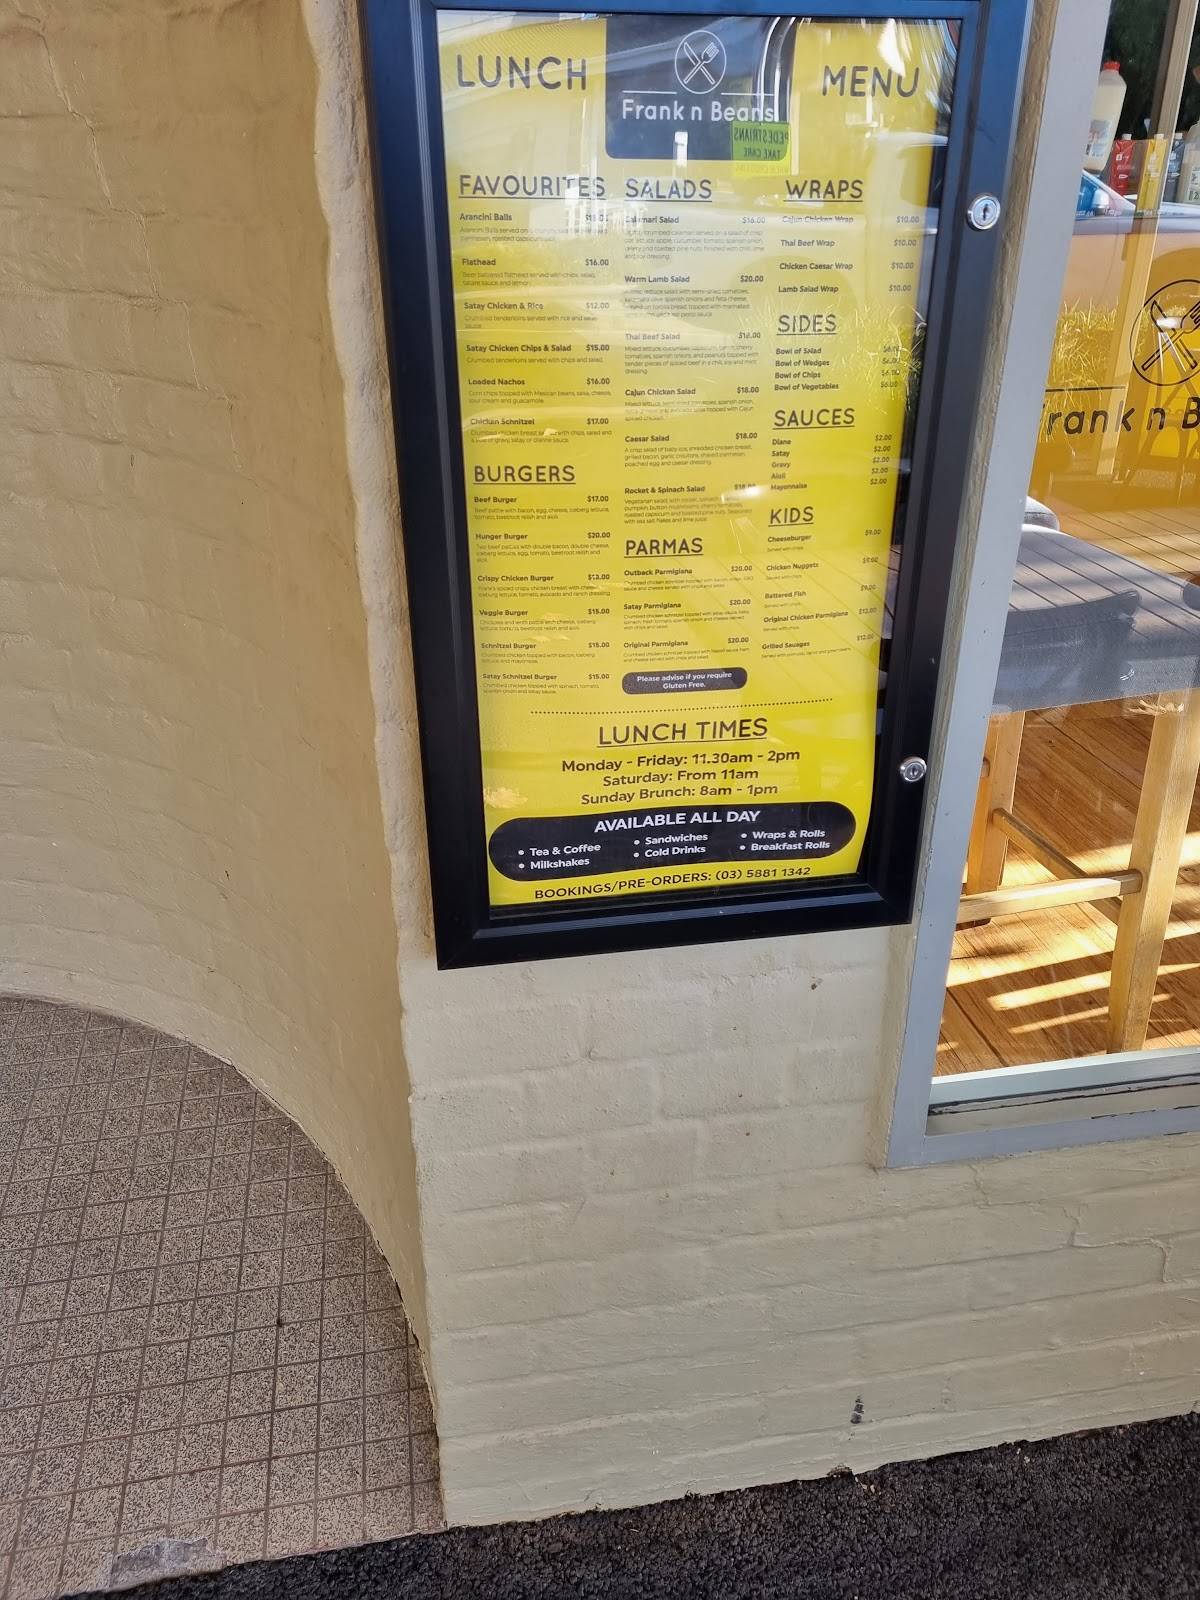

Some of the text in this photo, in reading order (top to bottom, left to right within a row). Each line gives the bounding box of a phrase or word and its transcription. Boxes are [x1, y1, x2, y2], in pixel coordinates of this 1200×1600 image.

[457, 54, 586, 90] LUNCH
[822, 65, 919, 97] MENU
[622, 99, 773, 121] Frank n Beans
[460, 175, 606, 197] FAVOURITES
[625, 178, 713, 199] SALADS
[785, 180, 864, 199] WRAPS
[460, 213, 512, 221] Arancini Balls
[778, 314, 837, 333] SIDES
[625, 389, 645, 397] Cajun
[774, 408, 855, 427] SAUCES
[1042, 400, 1136, 435] rank
[1147, 407, 1166, 430] n
[624, 435, 649, 443] Caesar
[772, 450, 790, 458] Satay
[474, 465, 575, 482] BURGERS
[771, 483, 808, 491] Mayonnaise
[492, 496, 517, 504] Burger
[587, 495, 609, 503] $17.00
[770, 506, 814, 524] KIDS
[475, 533, 502, 541] Hunger
[767, 535, 812, 543] Cheeseburger
[625, 537, 703, 555] PARMAS
[624, 568, 693, 577] Outback Parmigiana
[478, 575, 499, 583] Crispy
[479, 609, 528, 617] Veggie Burger
[624, 602, 681, 612] Satay Parmigiana
[764, 615, 788, 623] Original
[815, 611, 848, 619] Parmigiana
[624, 640, 688, 650] Original Parmigiana
[727, 636, 749, 644] $20.00
[663, 682, 687, 690] Gluten
[599, 717, 768, 745] LUNCH TIMES
[561, 750, 800, 773] Monday Friday: 11.30am 2pm
[603, 769, 759, 787] Saturday: From 11am
[581, 784, 778, 806] Sunday Brunch: 8am 1pm
[594, 810, 760, 833] AVAILABLE ALL DAY
[645, 833, 708, 845] Sandwiches
[752, 829, 826, 840] Wraps Rolls
[530, 844, 601, 857] Tea Coffee
[644, 846, 706, 858] Cold Drinks
[750, 841, 830, 851] Breakfast Rolls
[530, 857, 590, 870] Milkshakes
[535, 867, 811, 899] BOOKINGS/PRE-ORDERS: (03) 5881 1342
